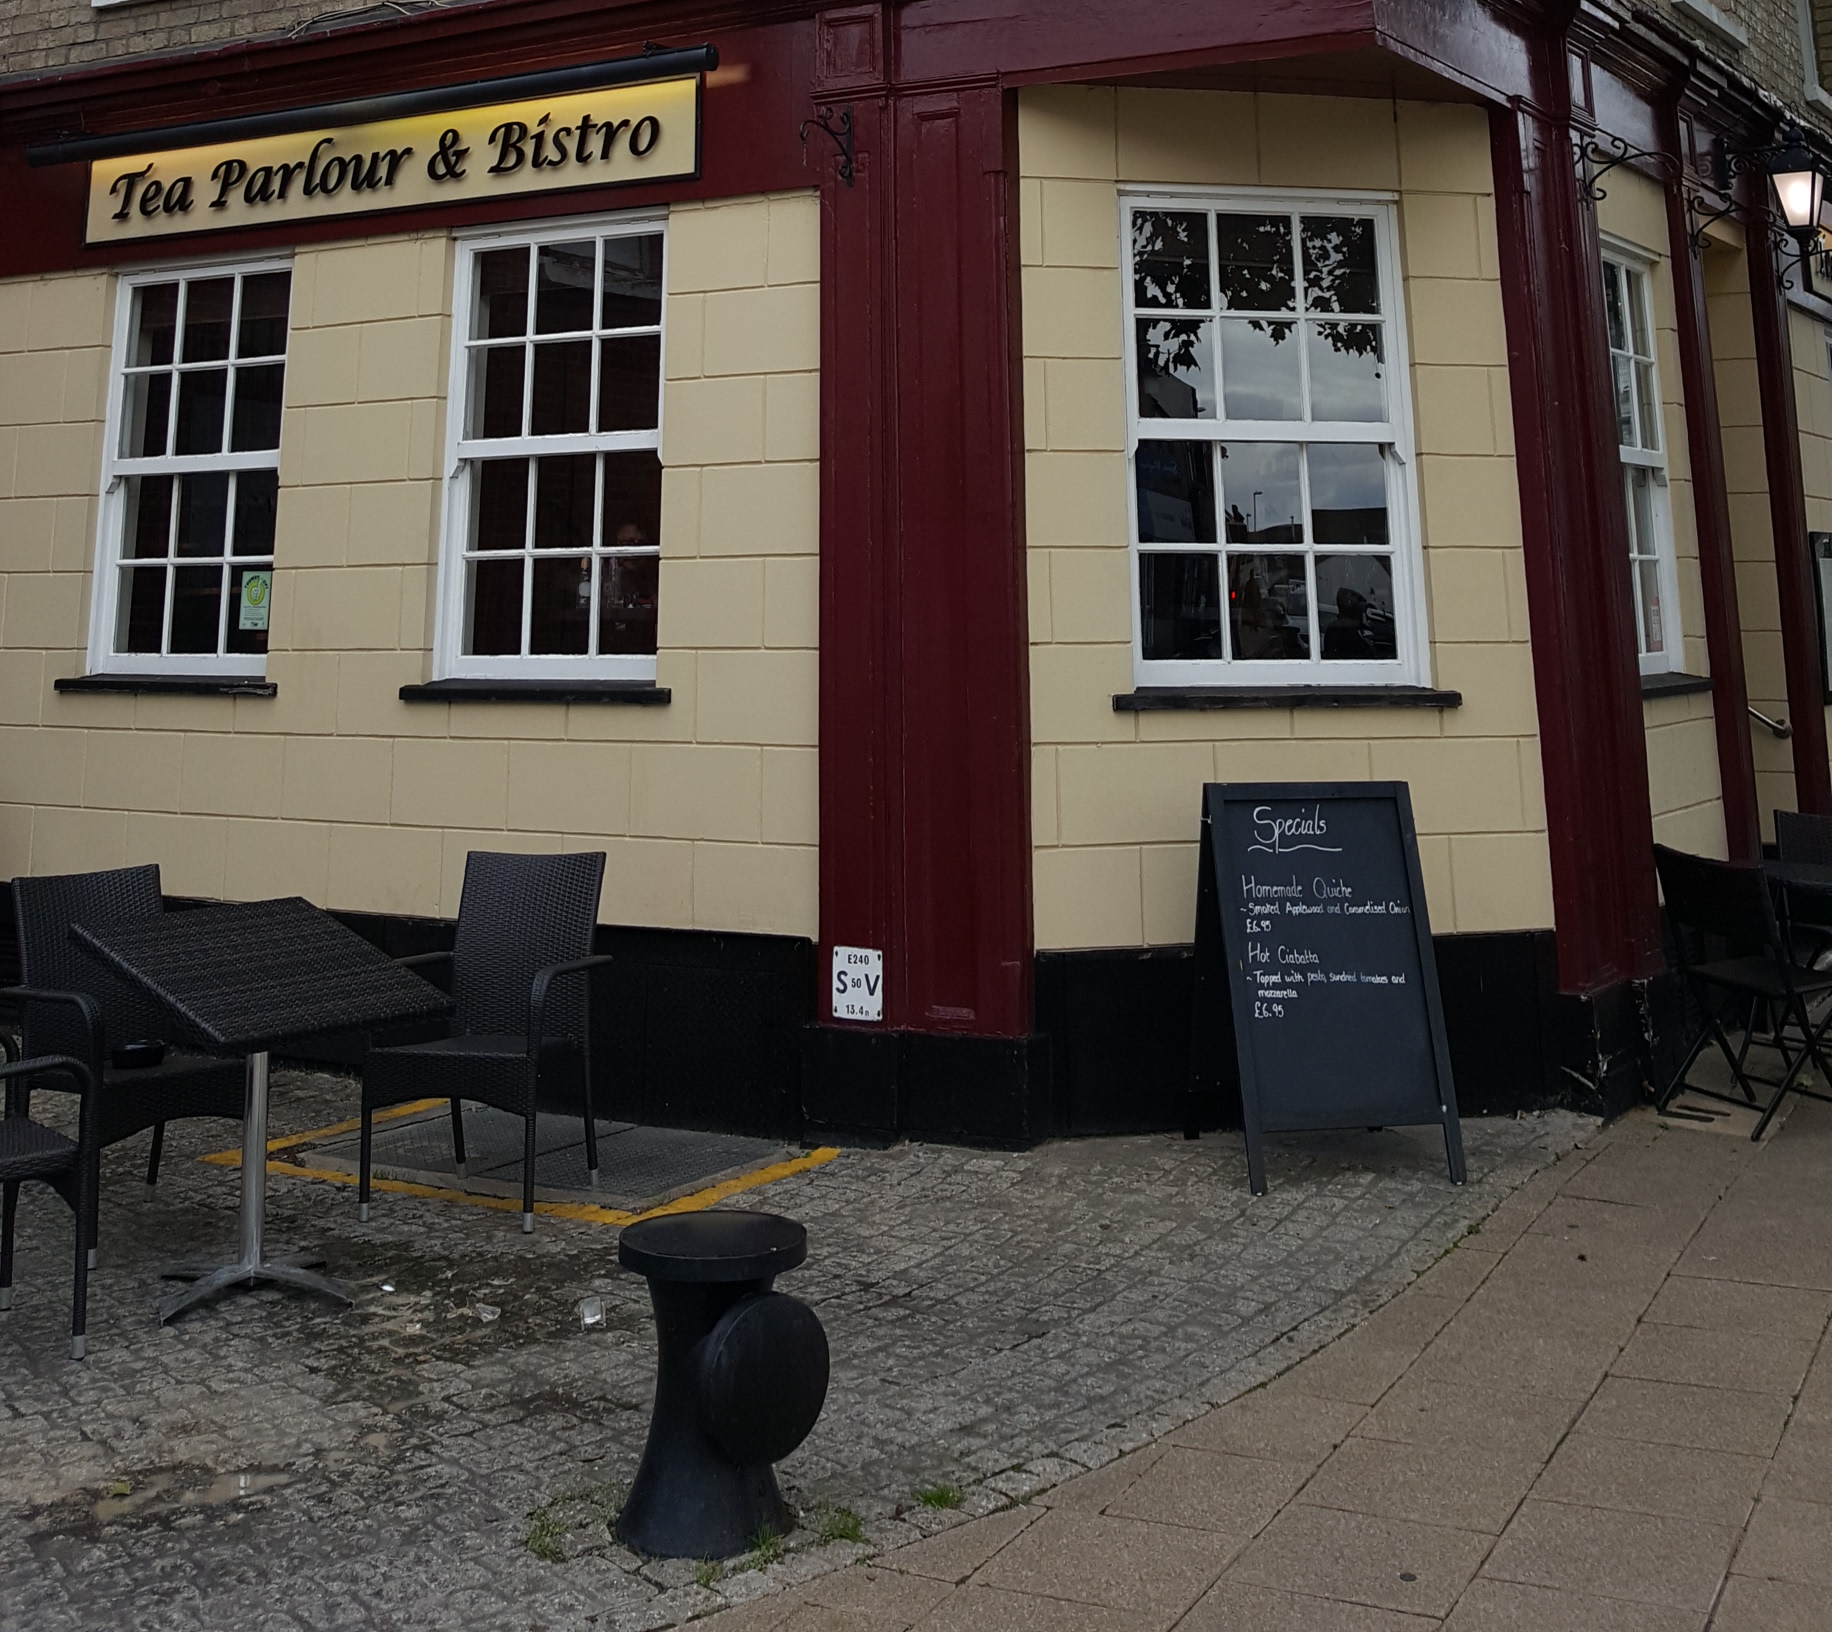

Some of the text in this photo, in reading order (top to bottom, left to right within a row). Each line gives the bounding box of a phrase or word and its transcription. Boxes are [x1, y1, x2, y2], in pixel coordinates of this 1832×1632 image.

[109, 112, 660, 221] Tea Parlour & Bistro
[1253, 803, 1327, 854] Specials
[1242, 875, 1352, 898] Homemade Quiche
[1249, 900, 1411, 916] Smoked Applewood and Caramelised Onion
[1246, 919, 1271, 933] £6.95
[847, 954, 870, 965] E240
[1248, 942, 1319, 964] Hot Ciabatta
[835, 970, 880, 997] S 50 V
[1253, 970, 1282, 987] Topped
[1284, 970, 1304, 983] with
[1391, 973, 1406, 984] and
[1258, 988, 1298, 999] mozzarella
[1254, 1001, 1284, 1018] £6.95
